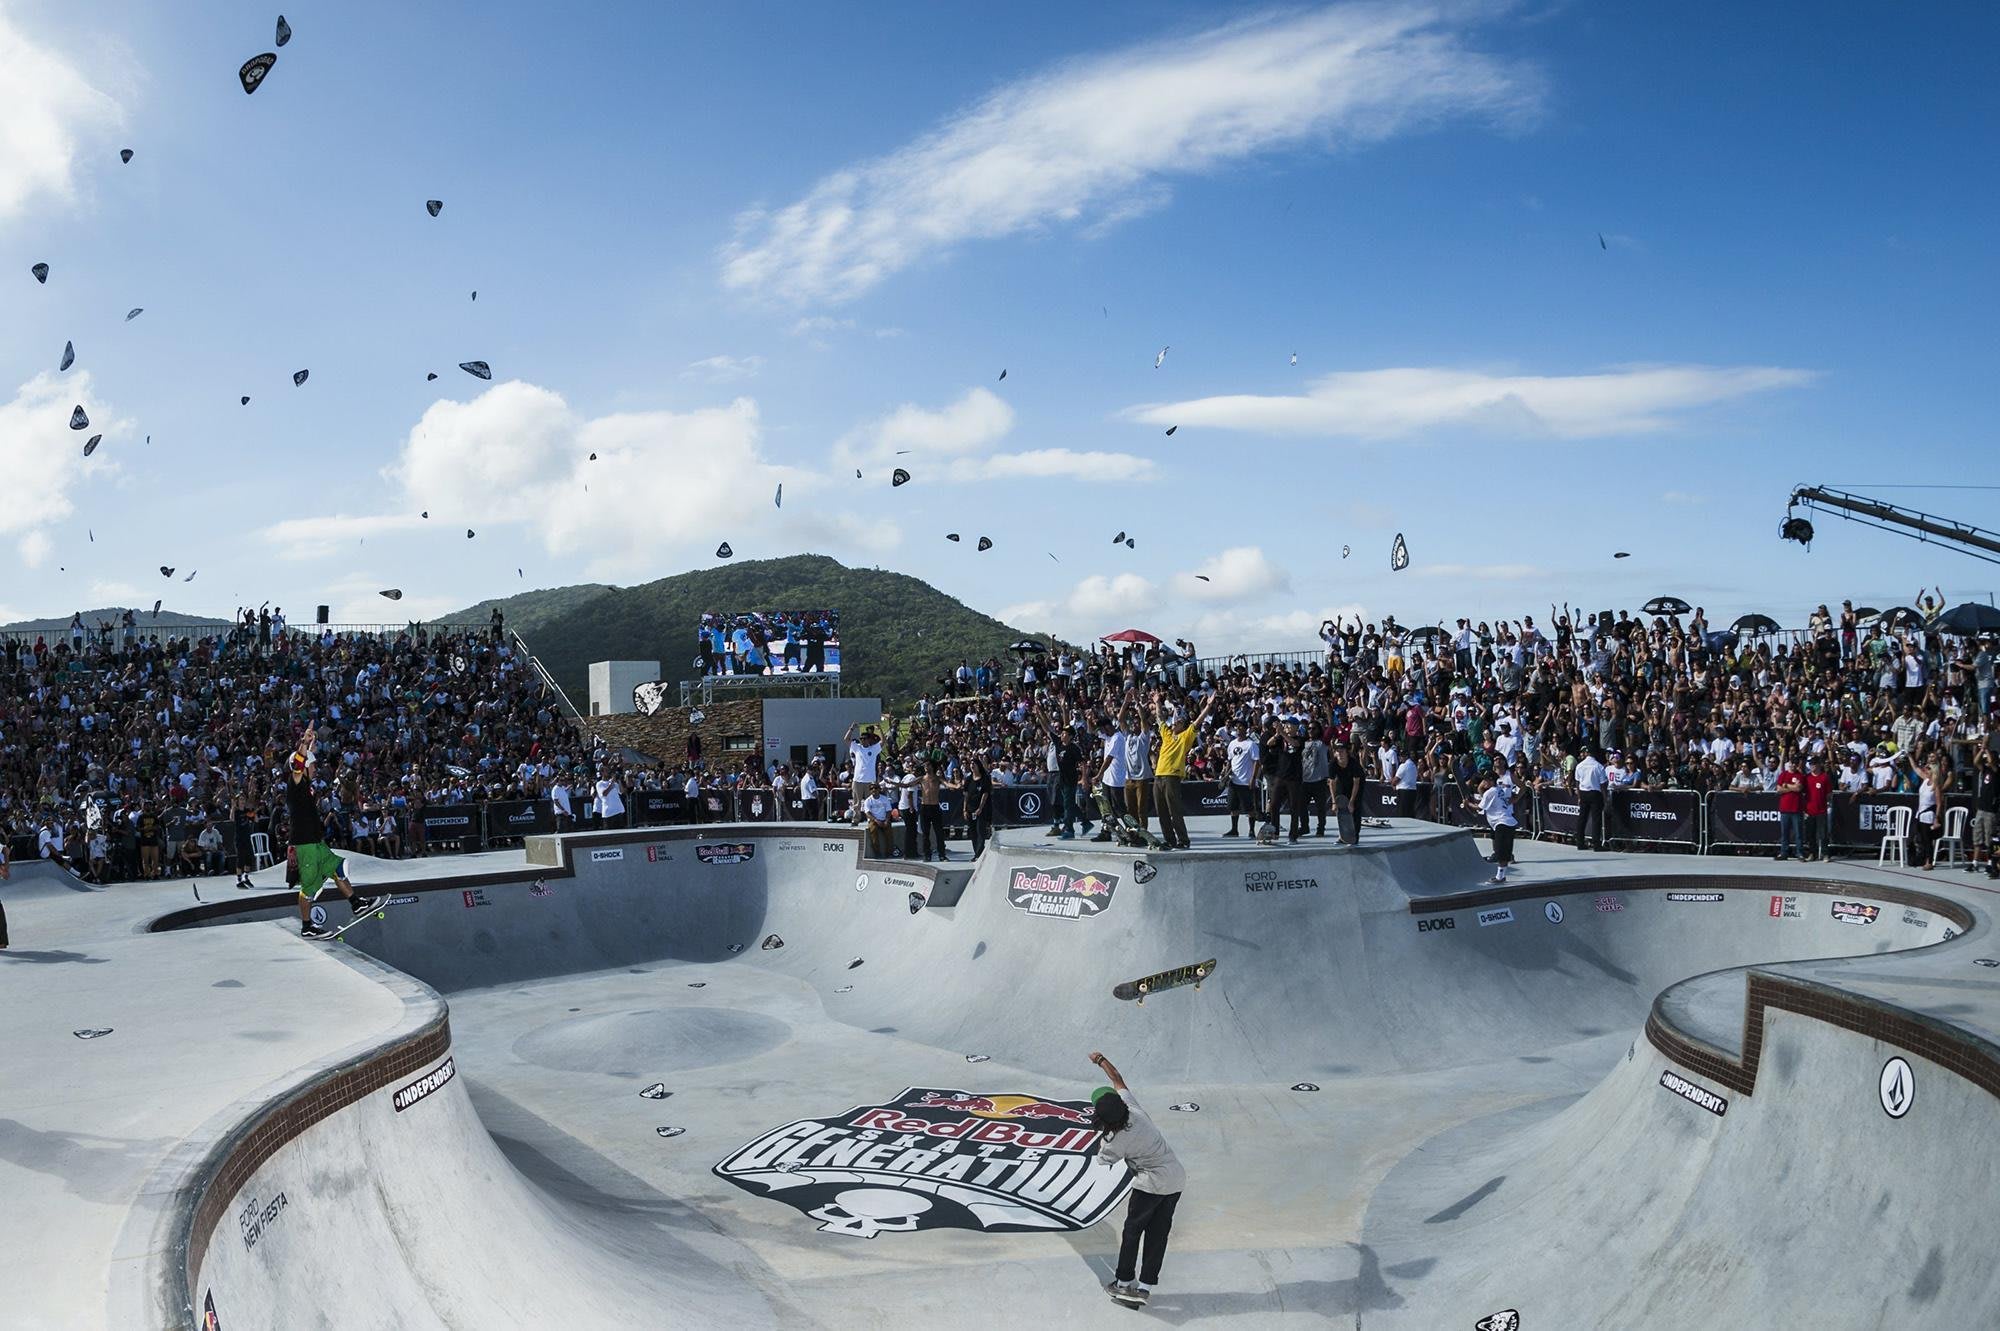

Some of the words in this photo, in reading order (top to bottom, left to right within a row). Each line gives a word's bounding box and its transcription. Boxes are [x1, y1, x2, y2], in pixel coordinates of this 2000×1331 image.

[1201, 797, 1228, 805] CERANI
[1382, 795, 1397, 805] EVO
[1630, 802, 1651, 811] FORD
[1552, 804, 1580, 815] INDEPENDEN
[1630, 811, 1649, 819] NEW
[1650, 812, 1677, 820] FIESTA
[593, 851, 621, 860] G-SHOCK
[1013, 872, 1042, 891] Red
[1039, 874, 1068, 893] Bull
[1244, 871, 1278, 882] FORD
[1245, 882, 1275, 892] NEW
[1277, 879, 1319, 890] FIESTA
[400, 1060, 453, 1107] INDEPENDENT
[1663, 1073, 1721, 1111] INDEPENDENT
[847, 1108, 978, 1139] Red
[983, 1119, 1103, 1153] Bull
[856, 1130, 1046, 1162] SKATE
[726, 1121, 1132, 1220] GENERATION
[239, 1198, 260, 1230] FORD
[244, 1220, 262, 1253] NEW
[259, 1191, 289, 1233] FIESTA
